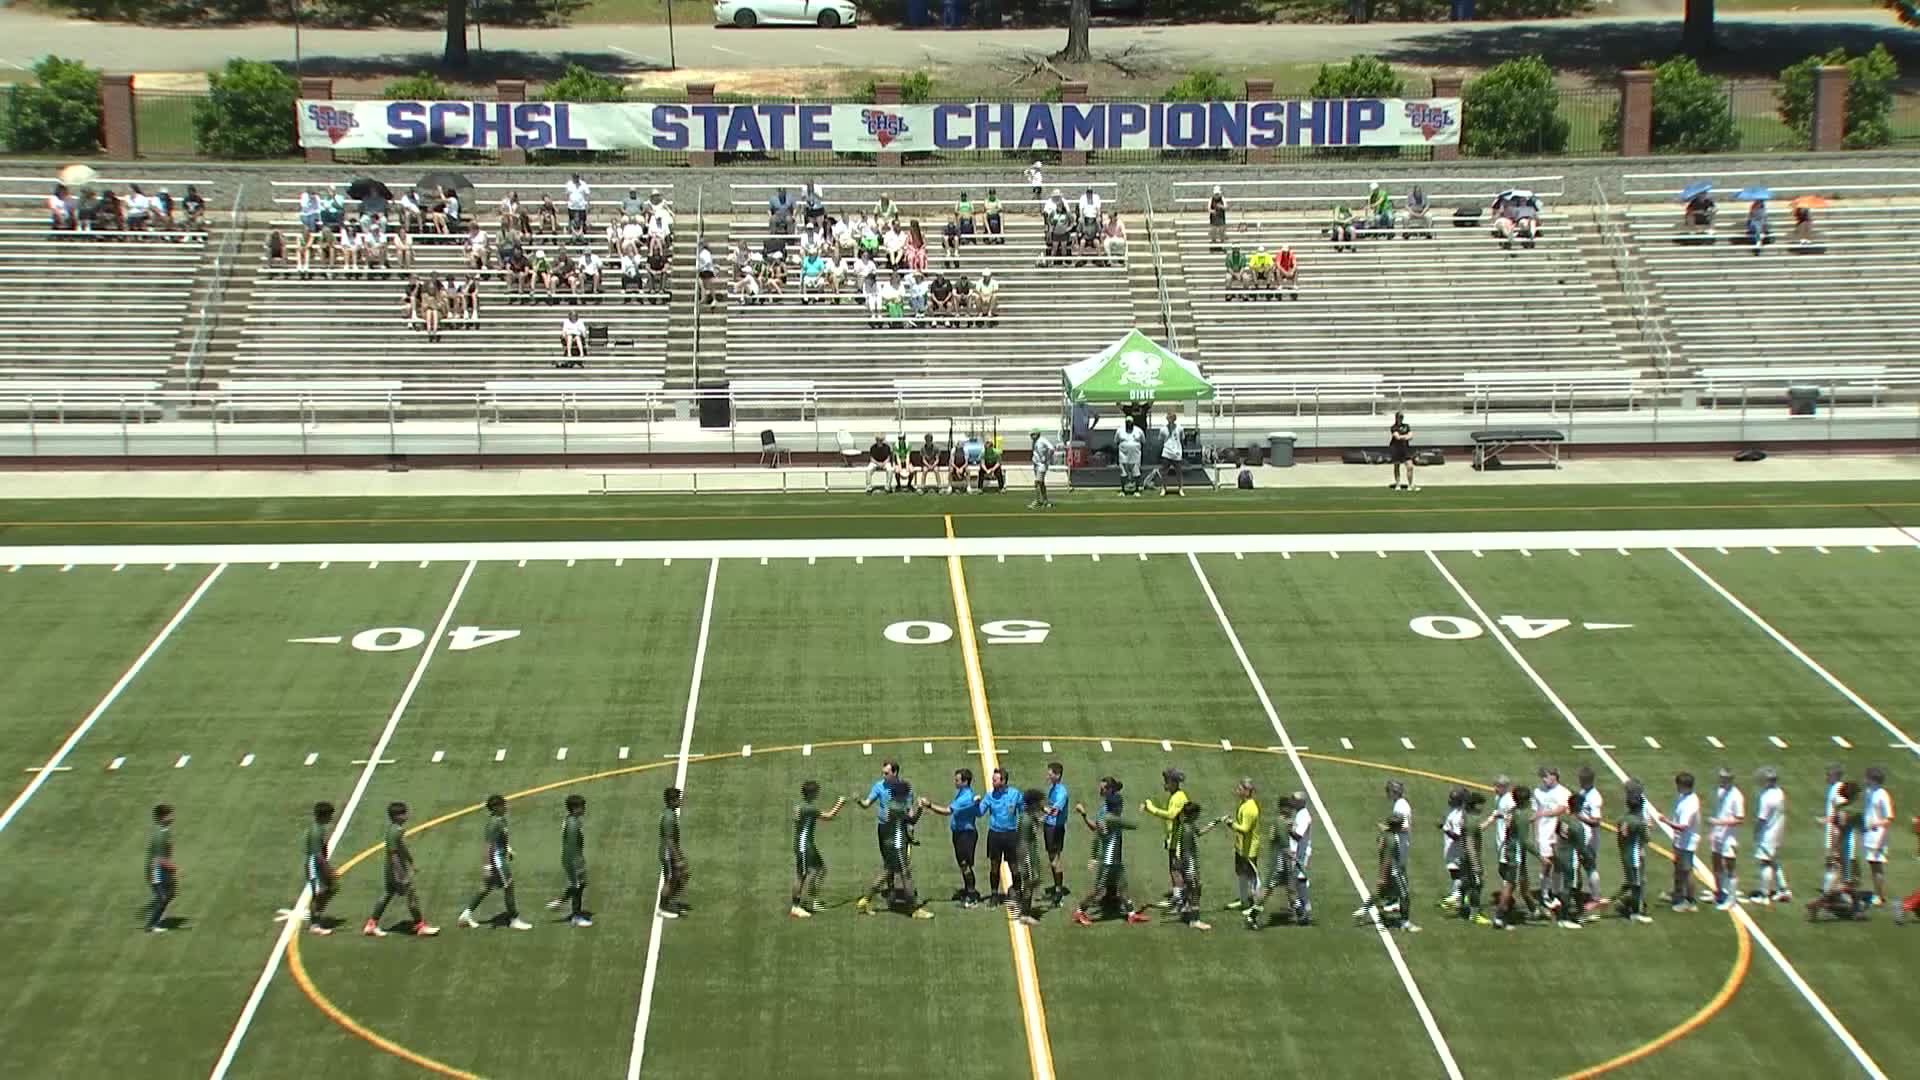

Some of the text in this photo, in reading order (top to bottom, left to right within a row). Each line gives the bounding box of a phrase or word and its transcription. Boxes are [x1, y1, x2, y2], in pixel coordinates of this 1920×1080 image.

[387, 98, 1385, 151] SCHSL STATE CHAMPIONSHIP
[861, 109, 909, 135] SCHSL
[1129, 389, 1156, 400] DIXIE
[351, 626, 521, 651] 40
[883, 620, 1051, 644] 50
[1409, 615, 1572, 639] 40
